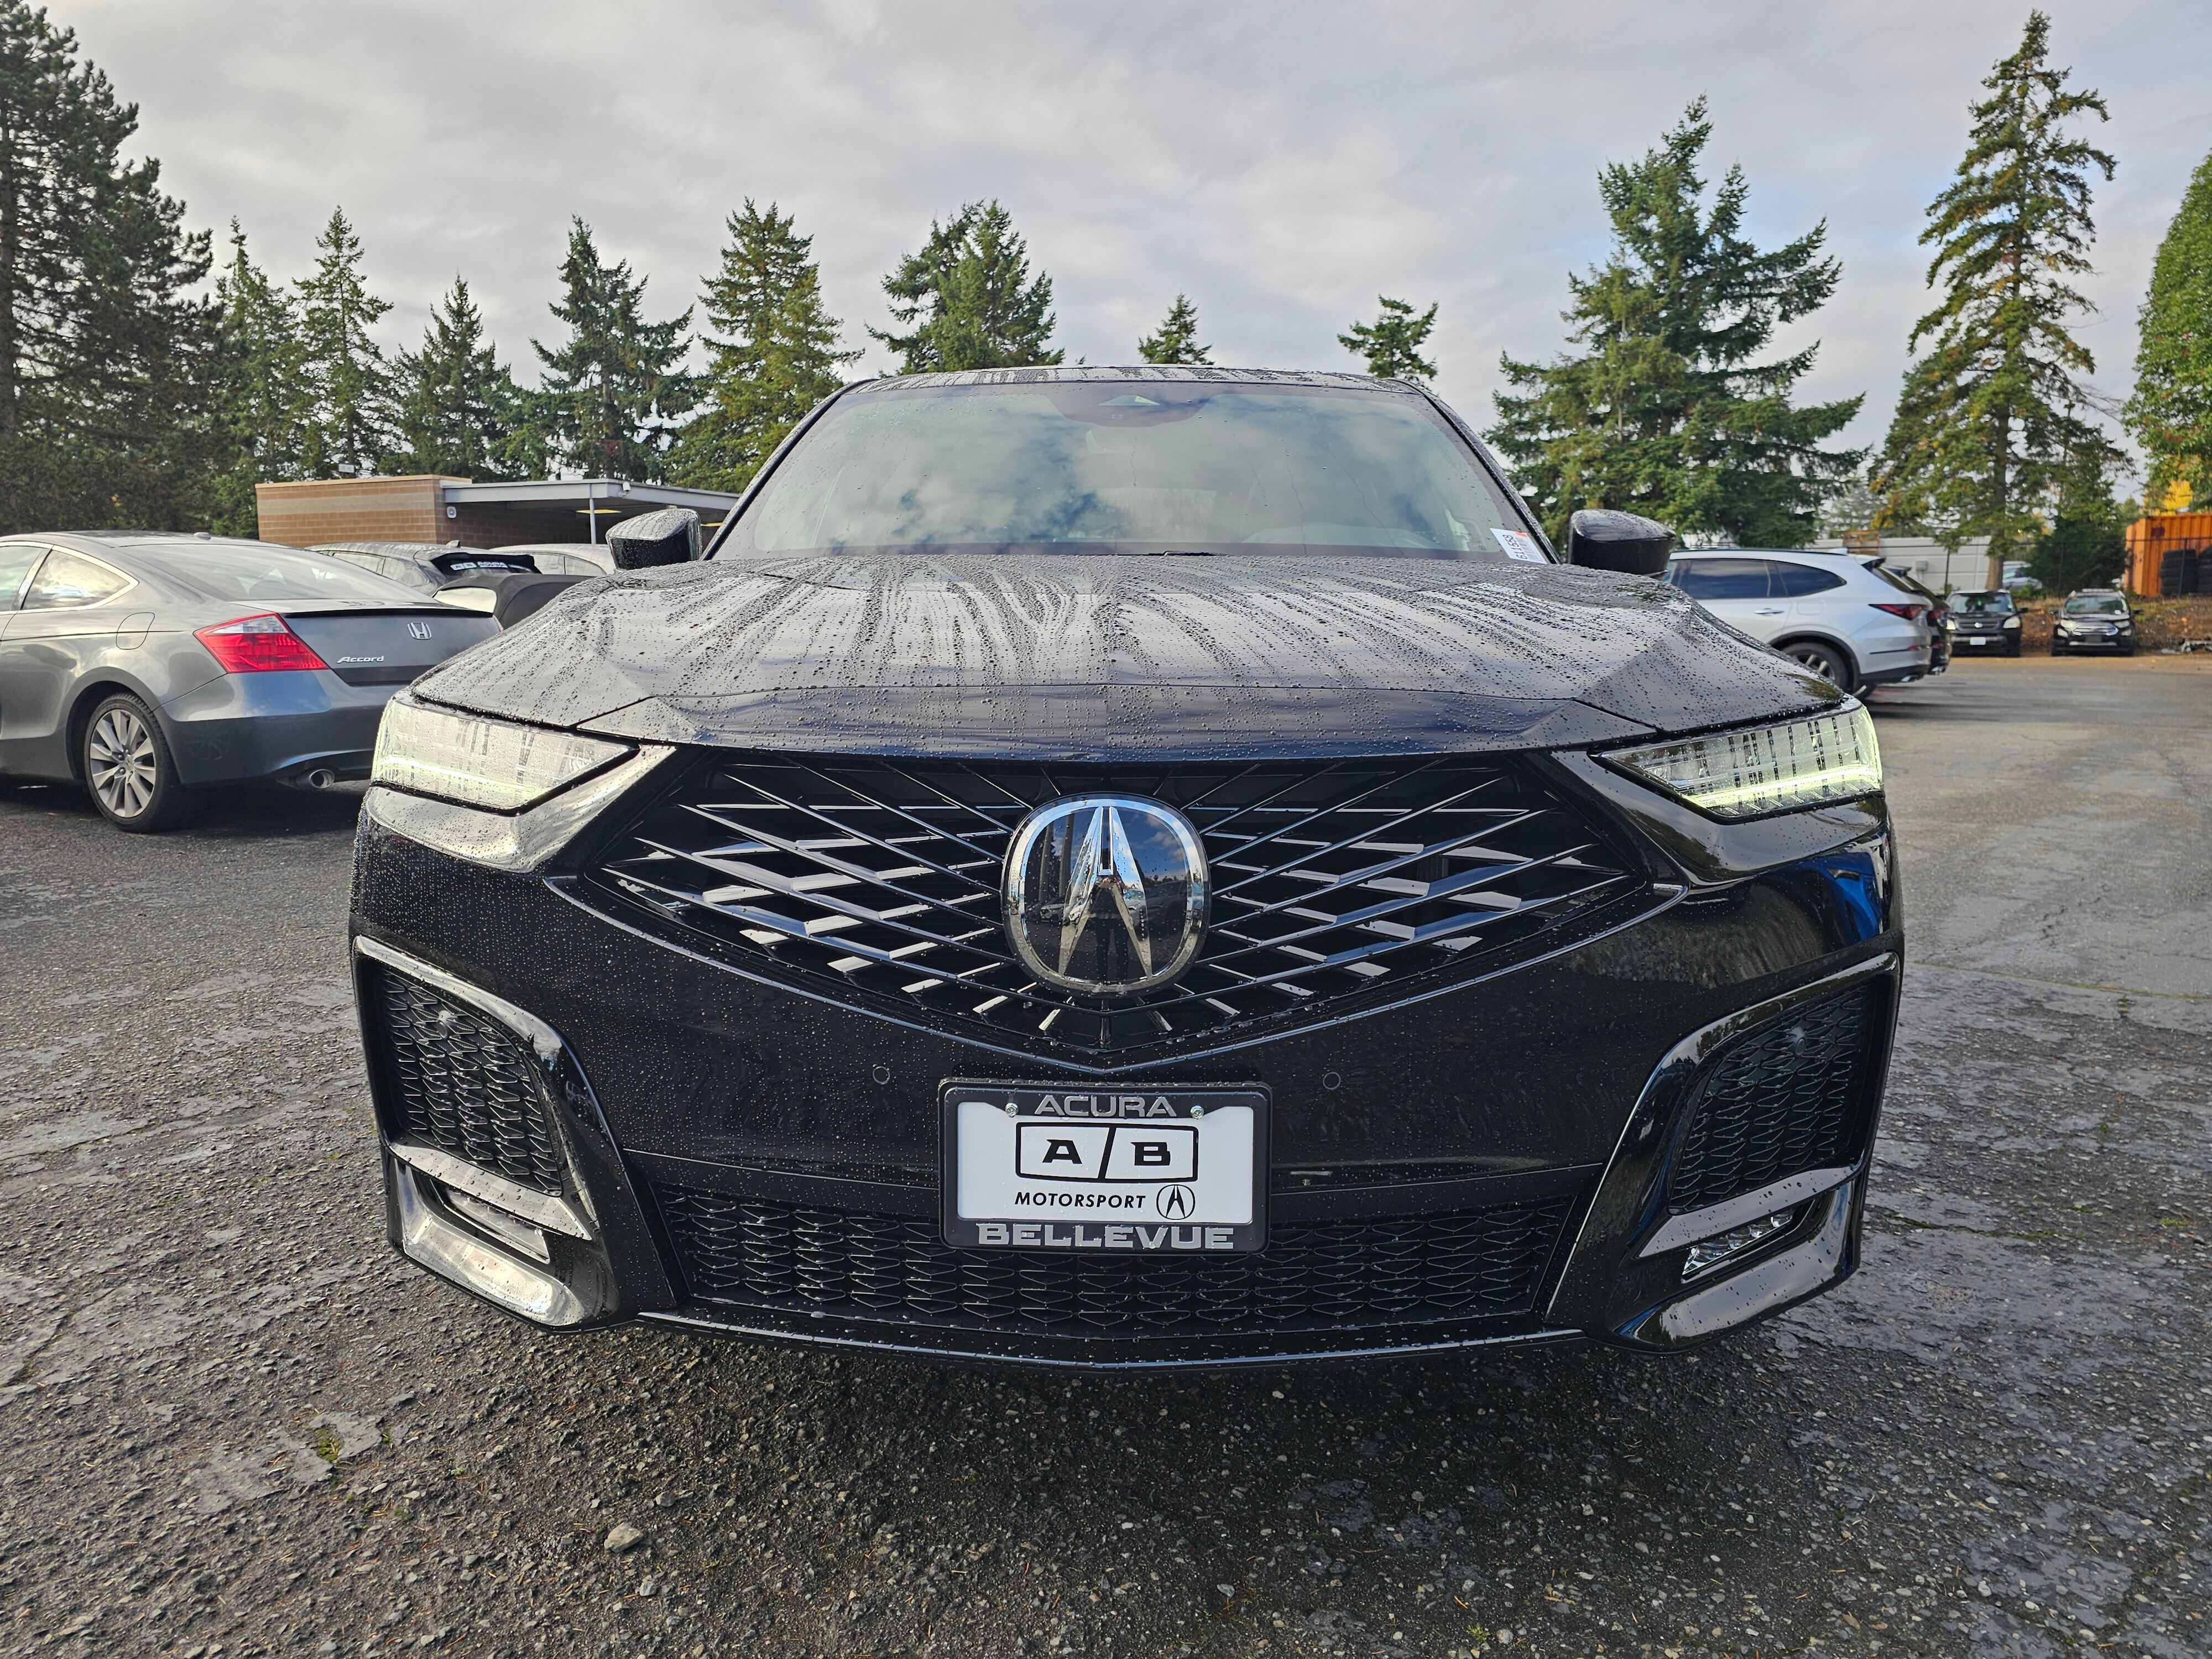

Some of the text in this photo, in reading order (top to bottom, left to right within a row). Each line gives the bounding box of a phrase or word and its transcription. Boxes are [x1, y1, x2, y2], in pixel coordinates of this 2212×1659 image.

[1503, 534, 1527, 559] 611558
[336, 655, 384, 664] Accord
[1034, 1095, 1177, 1118] ACURA
[1014, 1191, 1146, 1209] MOTORSPORT
[975, 1222, 1234, 1250] BELLEVUE
